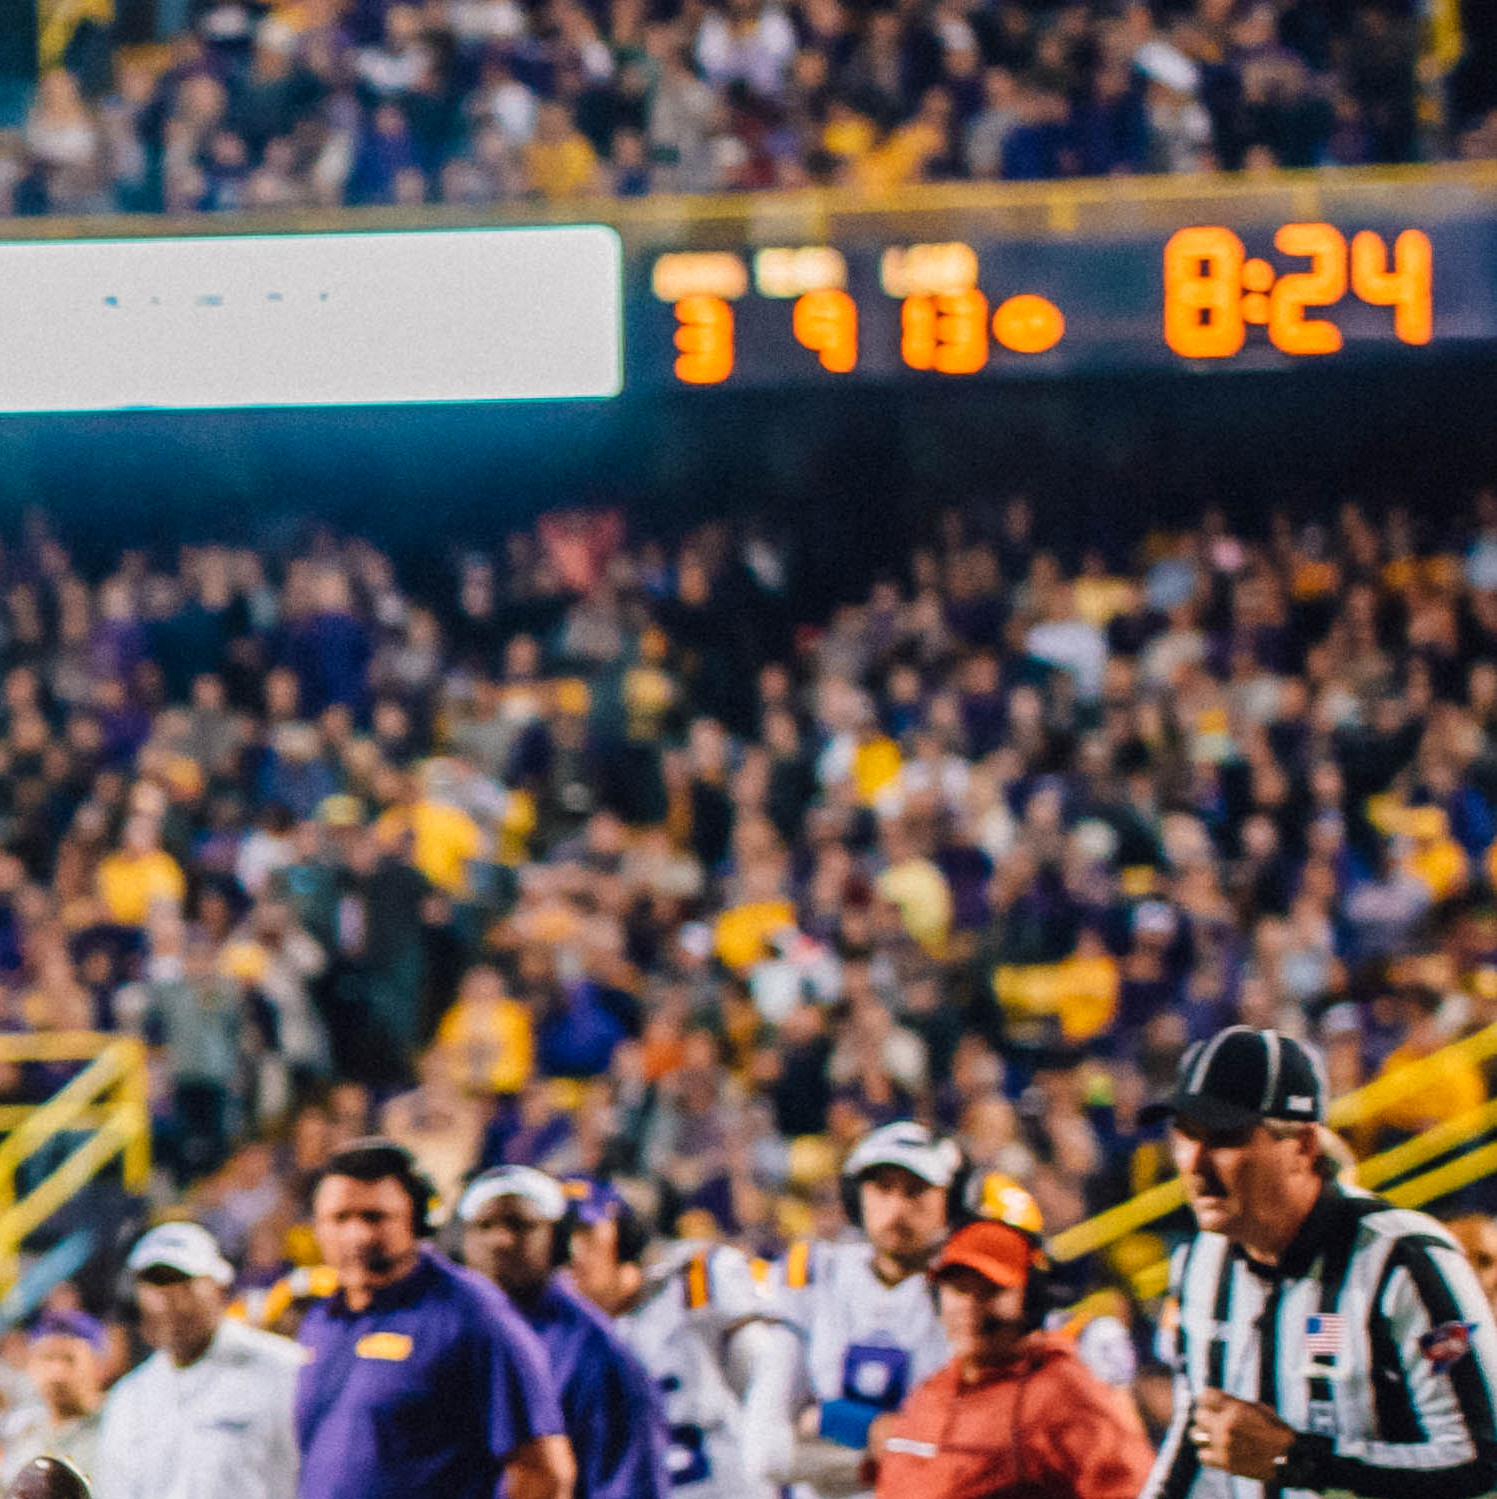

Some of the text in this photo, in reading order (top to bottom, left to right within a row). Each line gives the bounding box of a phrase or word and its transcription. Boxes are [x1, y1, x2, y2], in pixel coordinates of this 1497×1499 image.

[674, 296, 735, 385] 3
[793, 288, 857, 373] 9
[1164, 221, 1433, 358] 8:24
